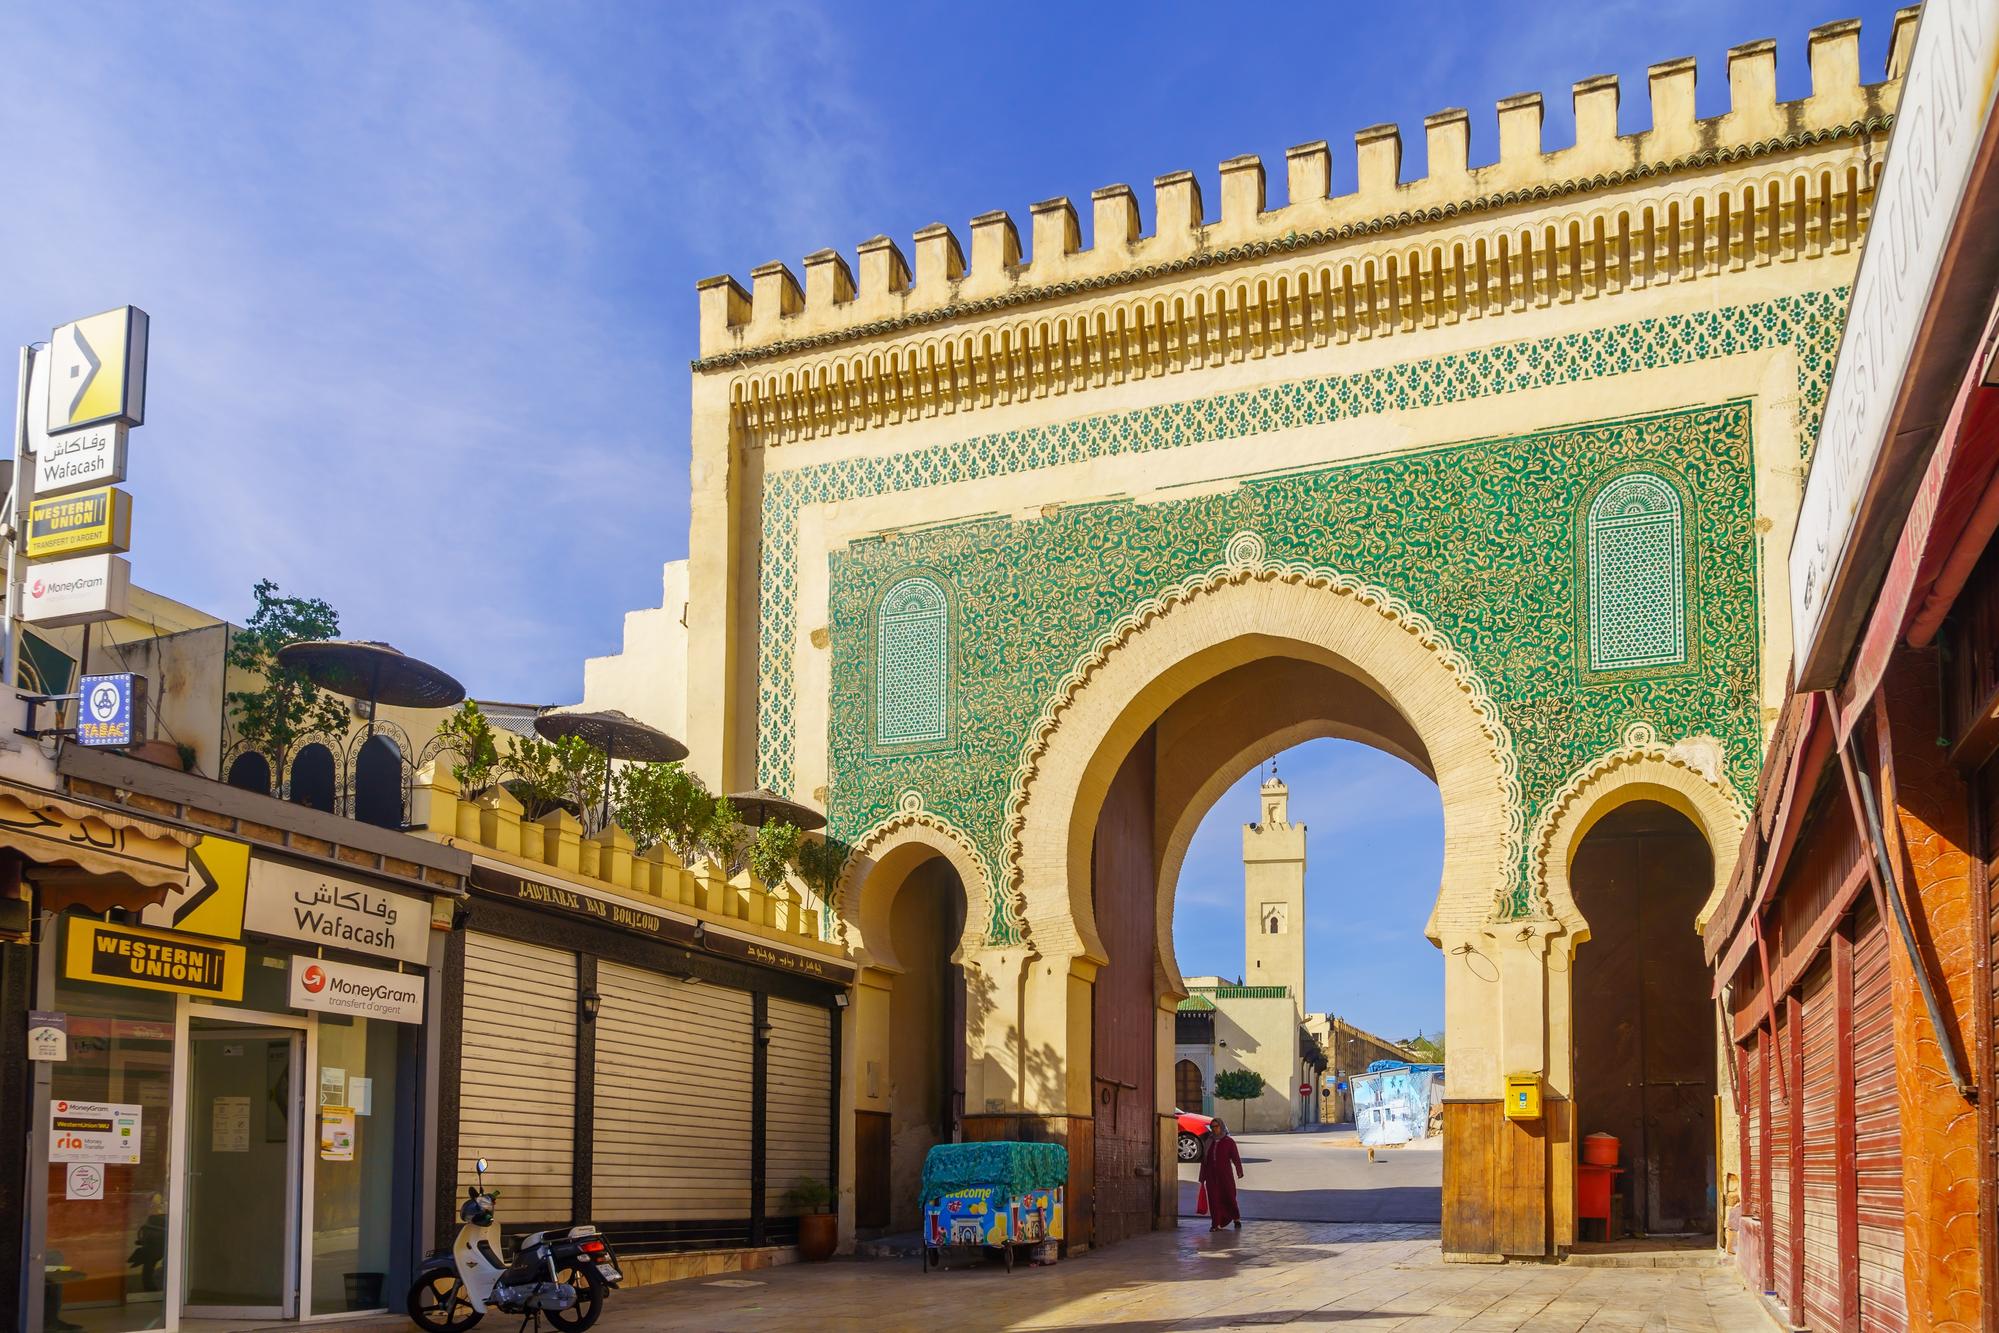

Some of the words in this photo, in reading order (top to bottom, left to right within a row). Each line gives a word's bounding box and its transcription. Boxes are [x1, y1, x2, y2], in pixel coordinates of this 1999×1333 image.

[44, 433, 106, 463] وفاكاش
[44, 454, 105, 481] Wafacash
[34, 499, 94, 521] WESTERN
[50, 511, 94, 530] UNION
[33, 537, 69, 551] TRANSFERT
[70, 531, 103, 545] D'ARGENT
[47, 578, 103, 593] MoneyGram
[83, 722, 125, 738] TABAC
[294, 883, 398, 926] وفاكاش
[585, 897, 607, 917] BAB
[294, 907, 395, 949] Wafacash
[96, 935, 204, 967] WESTERN
[130, 957, 203, 983] UNION
[329, 977, 416, 1004] MoneyGram
[328, 996, 367, 1010] transfert
[367, 1001, 401, 1015] d'argent
[69, 1104, 109, 1112] MoneyGram
[57, 1132, 82, 1149] ria
